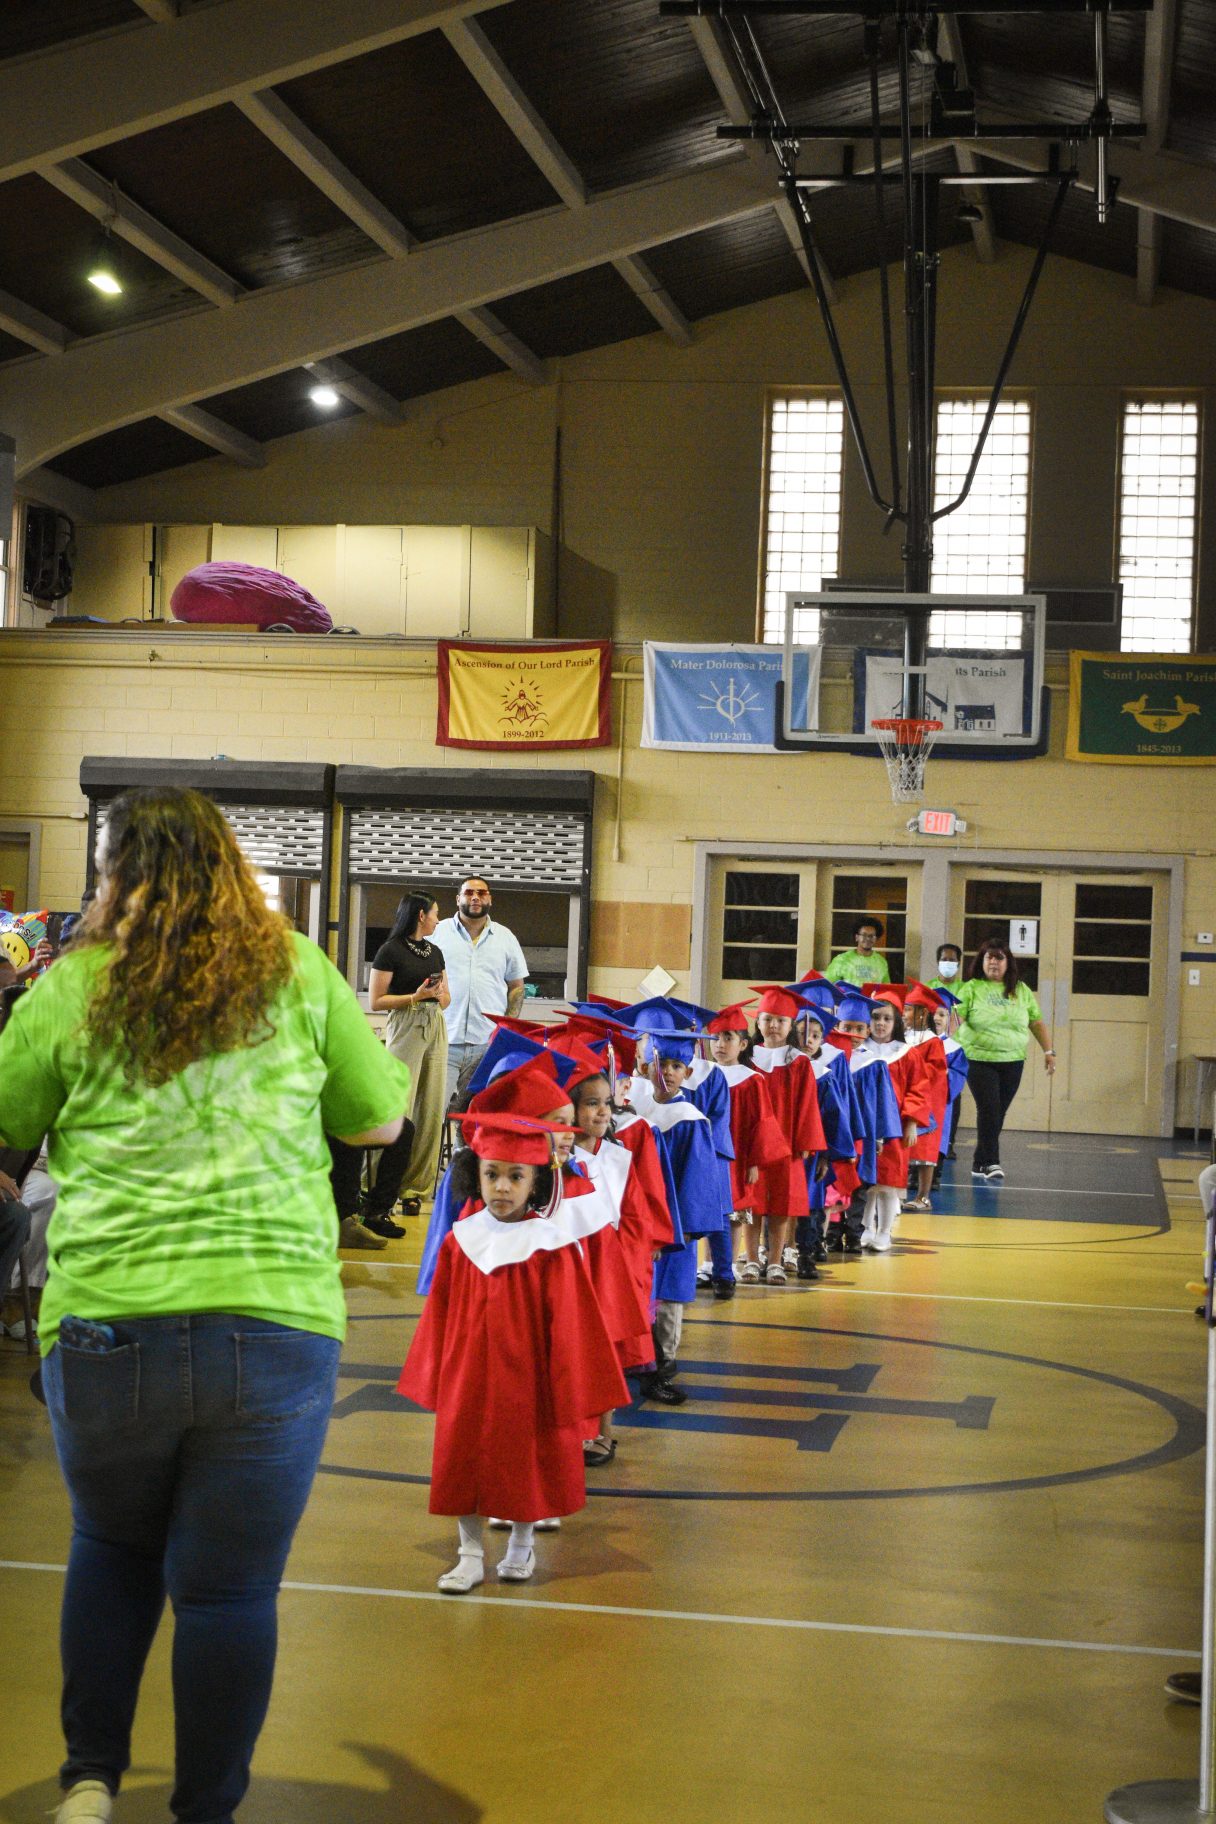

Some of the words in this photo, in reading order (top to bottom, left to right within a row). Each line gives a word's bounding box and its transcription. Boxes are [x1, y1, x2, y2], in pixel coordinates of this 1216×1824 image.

[454, 658, 503, 669] Ascension
[506, 661, 516, 670] of
[518, 660, 537, 670] Our
[540, 659, 563, 669] Lord
[565, 657, 595, 668] Parish
[670, 659, 704, 670] Mater
[706, 659, 755, 670] Dolorosa
[971, 666, 1006, 677] Parish
[1103, 669, 1132, 680] Saint
[1135, 669, 1182, 681] Joachim
[502, 730, 545, 739] 1899-2012
[925, 811, 952, 833] EXIT
